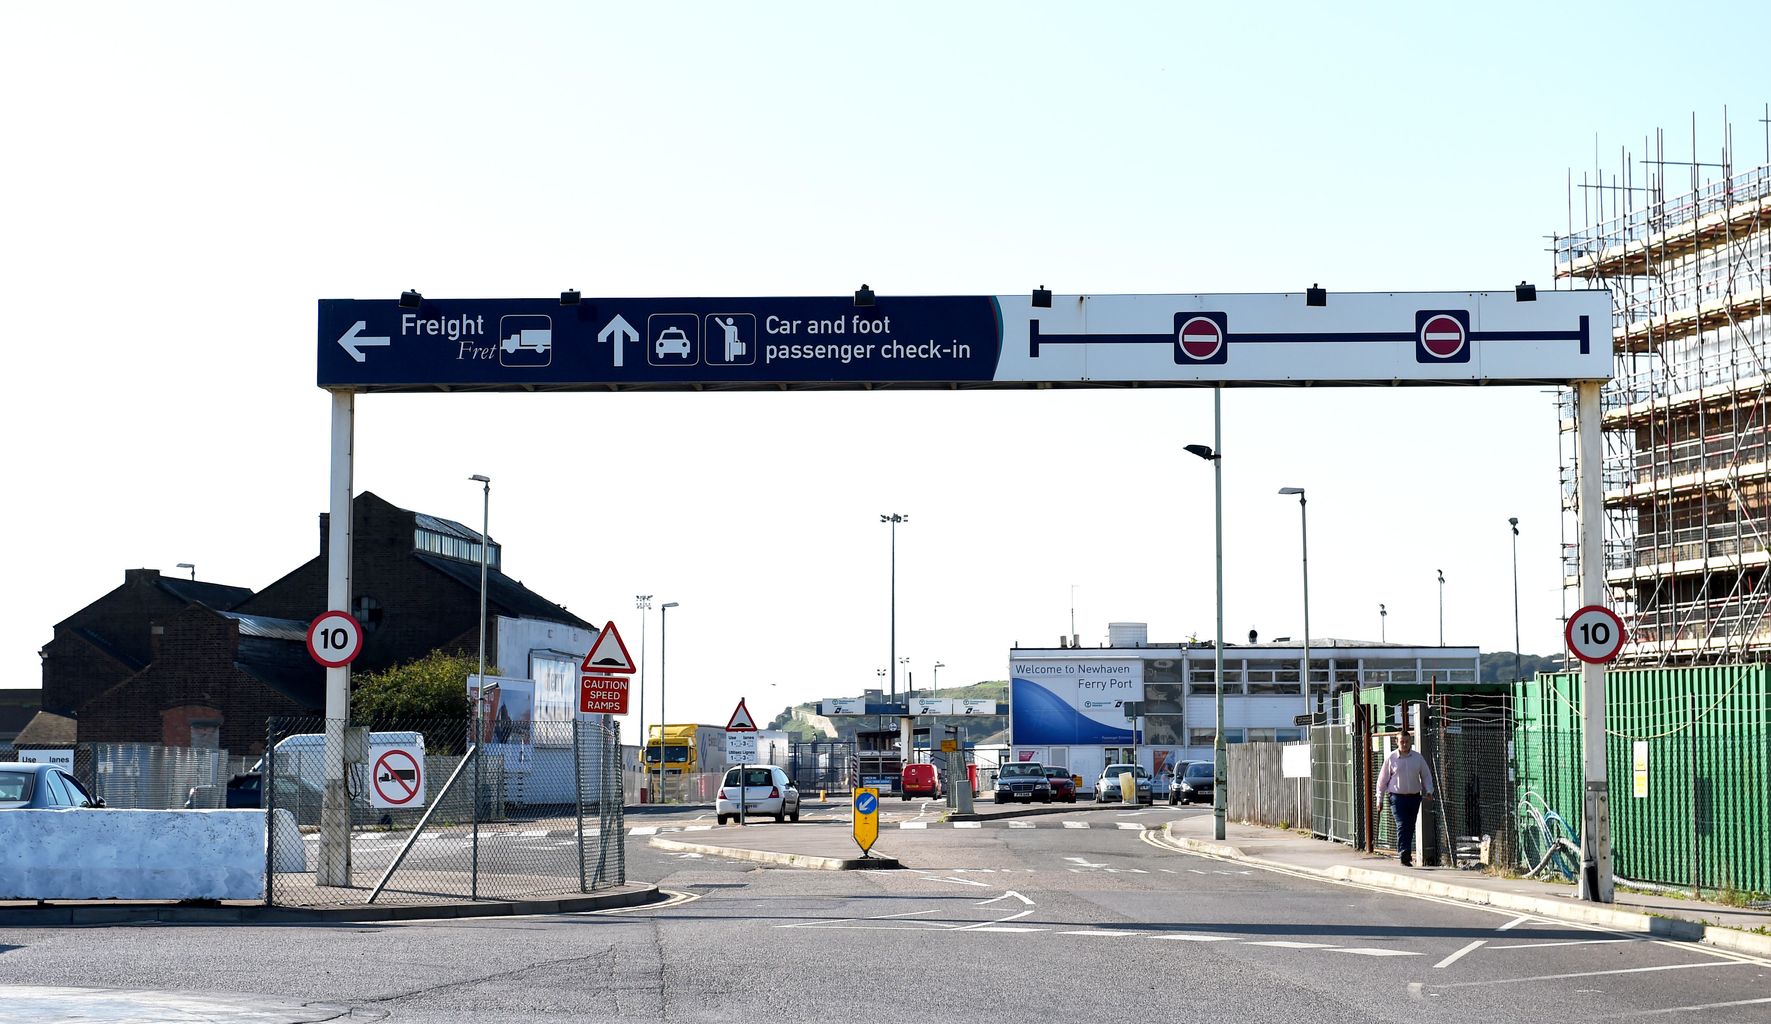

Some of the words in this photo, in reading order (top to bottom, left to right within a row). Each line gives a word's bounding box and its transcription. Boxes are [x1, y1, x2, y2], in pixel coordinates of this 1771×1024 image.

[402, 313, 484, 341] Freight
[766, 315, 802, 334] Car
[807, 315, 845, 334] and
[852, 315, 891, 334] foot
[456, 340, 497, 360] Fret
[766, 344, 875, 363] passenger
[881, 339, 971, 359] check-in
[320, 628, 349, 649] 10
[1580, 623, 1610, 645] 10
[1015, 664, 1062, 674] Welcome
[1065, 664, 1075, 674] to
[1078, 664, 1130, 674] Newhaven
[583, 679, 628, 690] CAUTION
[1078, 679, 1107, 691] Ferry
[1110, 679, 1133, 689] Port
[590, 691, 621, 700] SPEED
[587, 701, 620, 711] RAMPS
